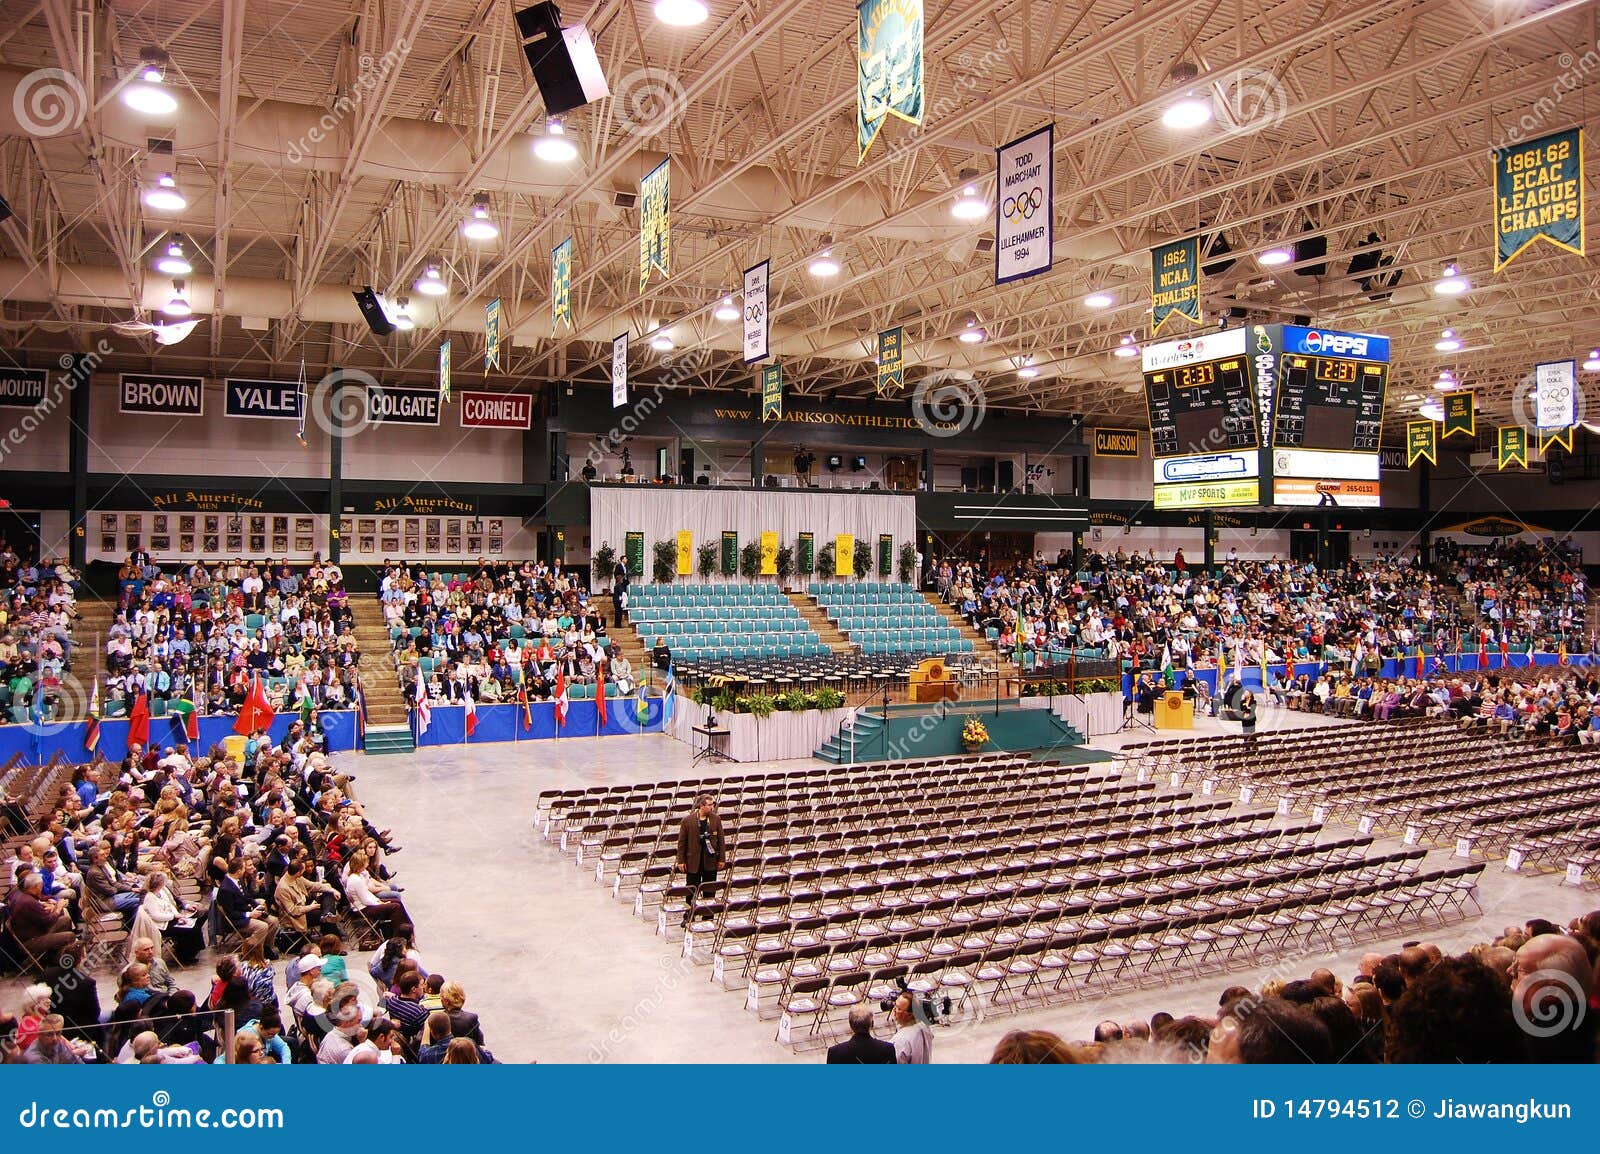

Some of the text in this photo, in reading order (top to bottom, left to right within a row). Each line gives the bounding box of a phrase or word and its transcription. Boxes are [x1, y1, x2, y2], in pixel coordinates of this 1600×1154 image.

[1015, 152, 1033, 168] TODD
[1005, 164, 1042, 188] MARCHANT
[1513, 163, 1563, 192] ECAC
[1500, 179, 1577, 215] LEAGUE
[1500, 200, 1577, 234] CHAMPS
[1001, 226, 1045, 250] LILLEHAMMER
[1014, 247, 1030, 261] 1994
[1163, 249, 1186, 268] 1962
[1160, 268, 1189, 287] NCAA
[1153, 284, 1198, 307] FINALIST
[1321, 334, 1369, 356] PEPSI
[1182, 365, 1213, 385] 2:37
[1255, 354, 1275, 397] GOLDEN
[1324, 361, 1355, 379] 2:37
[124, 382, 199, 407] BROWN
[235, 387, 296, 411] YALE
[370, 393, 436, 418] COLGATE
[465, 399, 527, 422] CORNELL
[1258, 398, 1272, 448] KNIGHTS
[1097, 434, 1136, 452] CLARKSON
[1380, 451, 1408, 468] UNION
[1197, 487, 1226, 499] SPORTS
[1346, 485, 1374, 493] 265-0133
[153, 491, 264, 509] All American
[197, 502, 219, 510] MEN
[374, 496, 474, 513] All American
[413, 505, 433, 513] MEN
[1187, 514, 1200, 525] All
[635, 538, 643, 573] Clarkson
